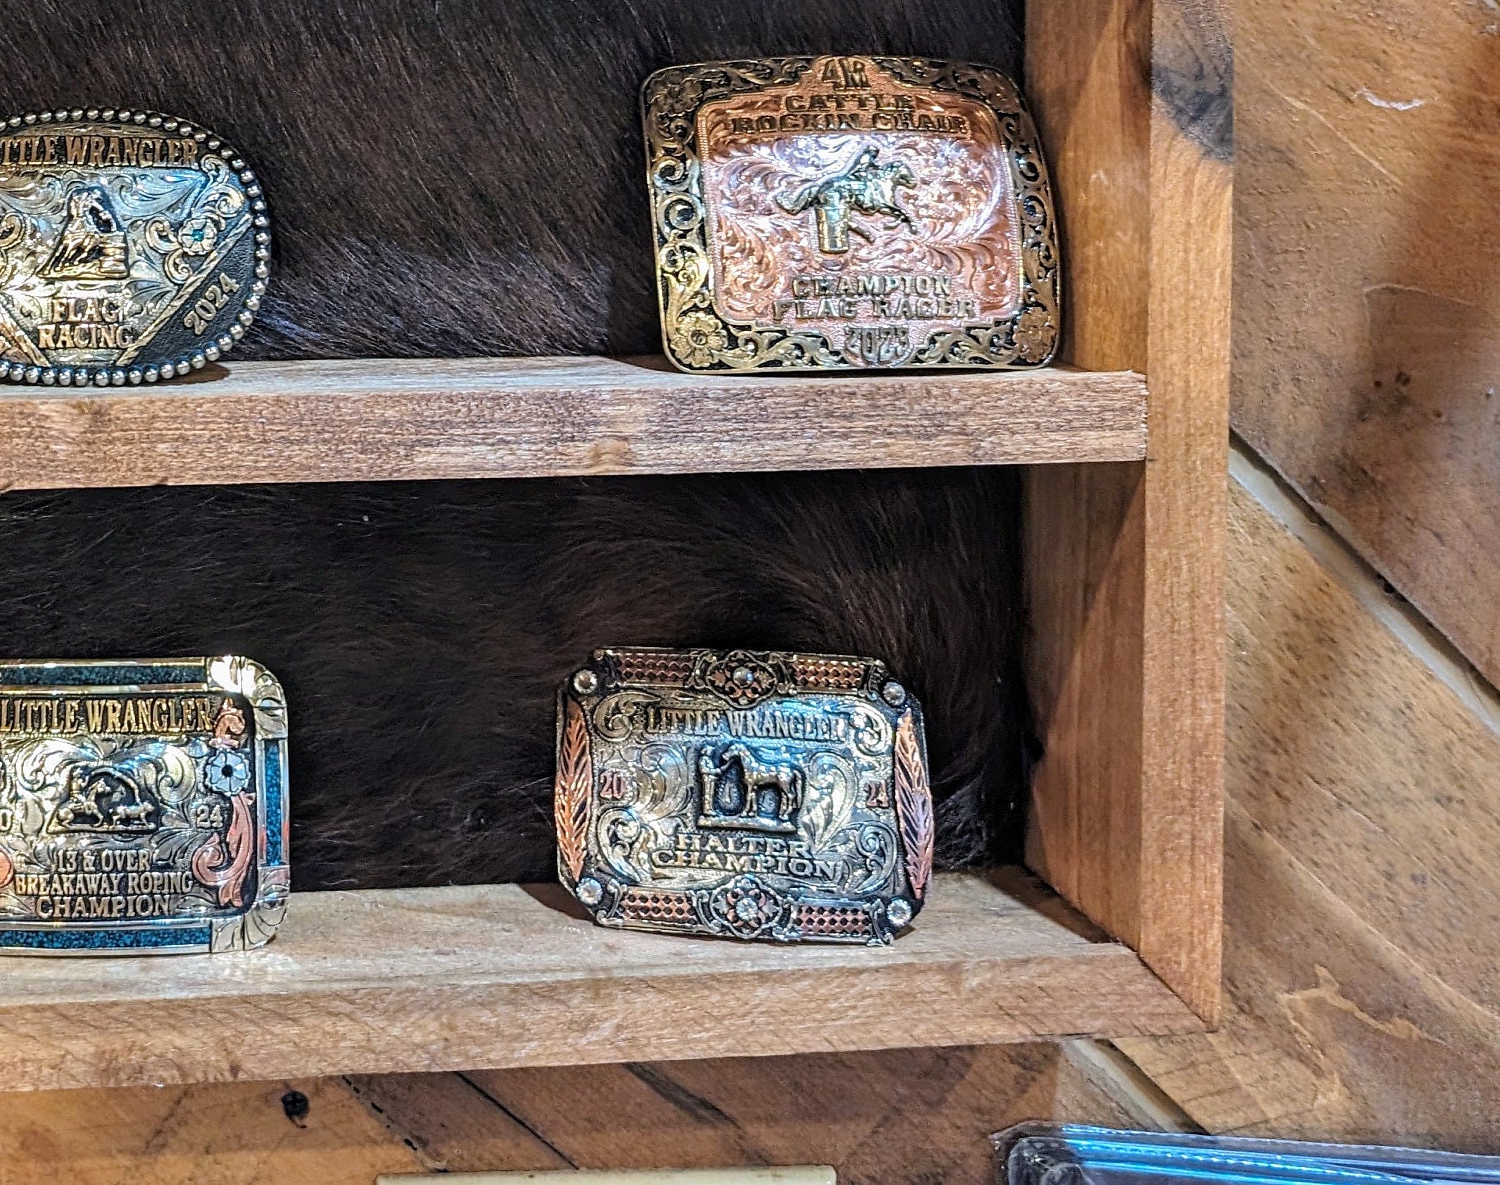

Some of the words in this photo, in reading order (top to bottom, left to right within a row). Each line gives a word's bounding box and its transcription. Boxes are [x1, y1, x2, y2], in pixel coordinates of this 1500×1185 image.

[786, 94, 915, 113] CATTLE
[732, 113, 860, 134] ROCKIN
[872, 113, 970, 135] CHAIR
[65, 136, 199, 167] WRANGLER
[792, 274, 950, 297] CHAMPION
[51, 297, 119, 323] FLAG
[183, 275, 240, 335] 2024
[773, 299, 858, 319] FLAG
[873, 298, 975, 319] RACER
[37, 323, 134, 350] RACING
[0, 699, 79, 734] LITTLE
[87, 698, 213, 733] WRANGLER
[649, 707, 722, 737] LITTLE
[729, 711, 847, 741] WRANGLER
[600, 773, 626, 799] 20
[865, 782, 890, 809] 24
[196, 805, 224, 830] 24
[676, 832, 812, 859] HALTER
[100, 849, 151, 872] OVER
[652, 850, 837, 881] CHAMPION
[15, 872, 123, 895] BREAKAWAY
[127, 871, 194, 895] ROPING
[36, 895, 171, 918] CHAMPION
